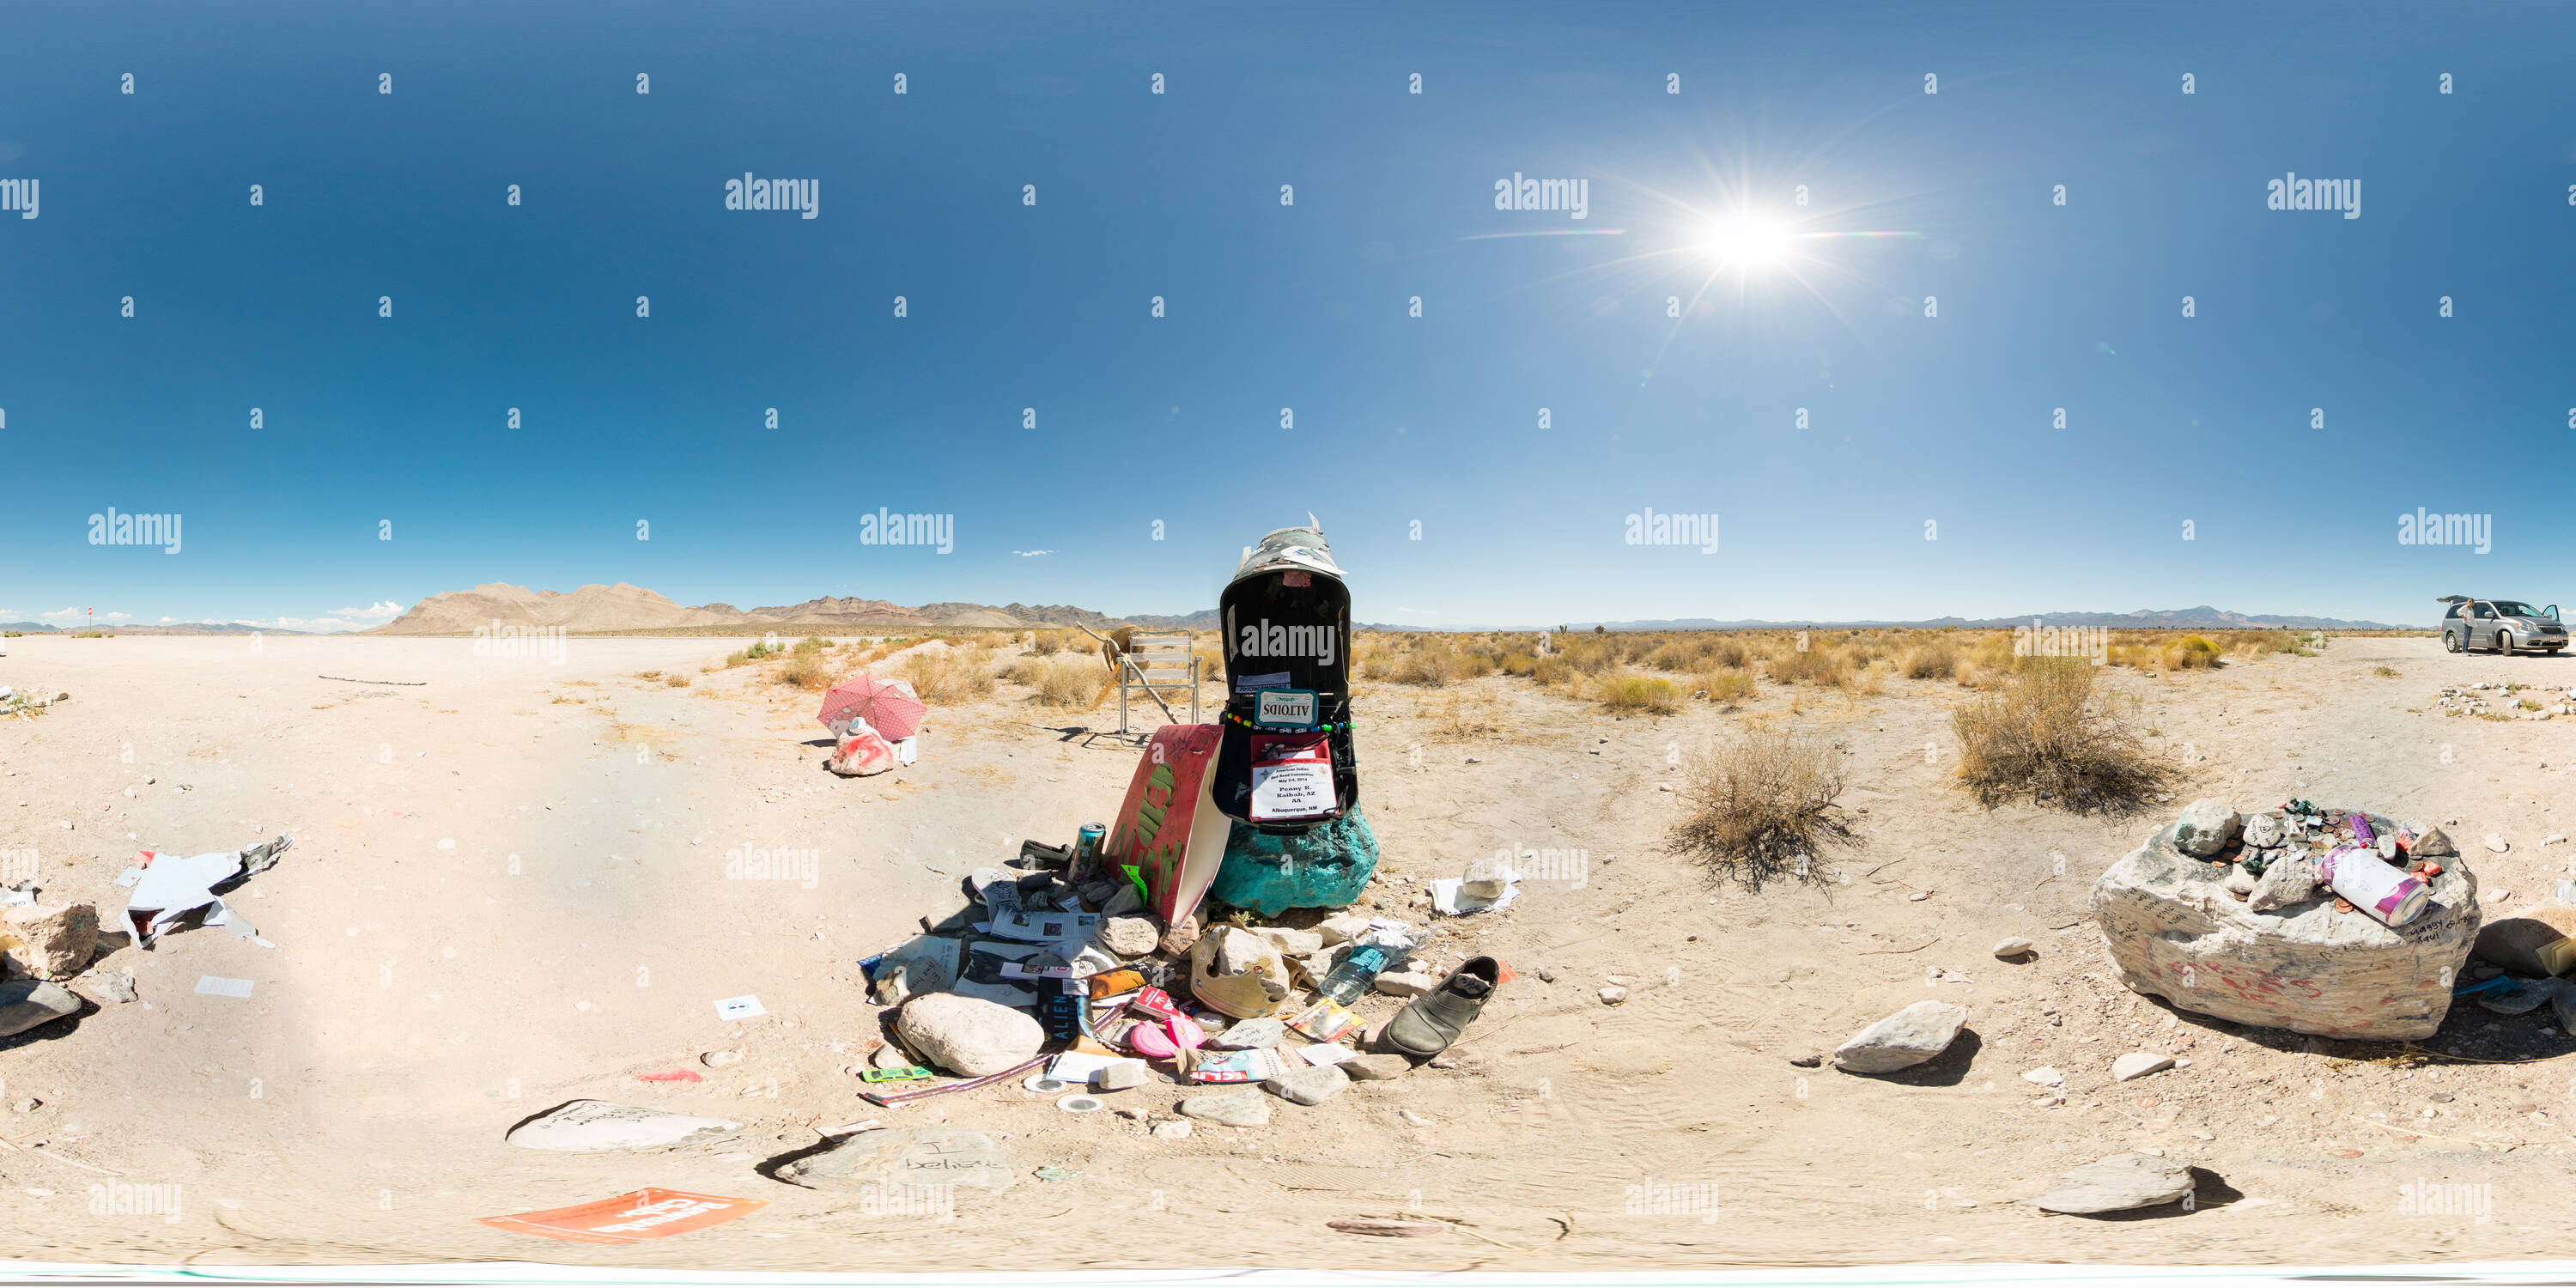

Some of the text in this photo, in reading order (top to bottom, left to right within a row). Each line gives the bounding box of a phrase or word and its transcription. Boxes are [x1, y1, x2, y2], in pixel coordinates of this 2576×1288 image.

[1263, 703, 1309, 716] ALTOIDS
[1054, 995, 1069, 1040] ALIEN
[587, 1201, 732, 1233] Rewards
